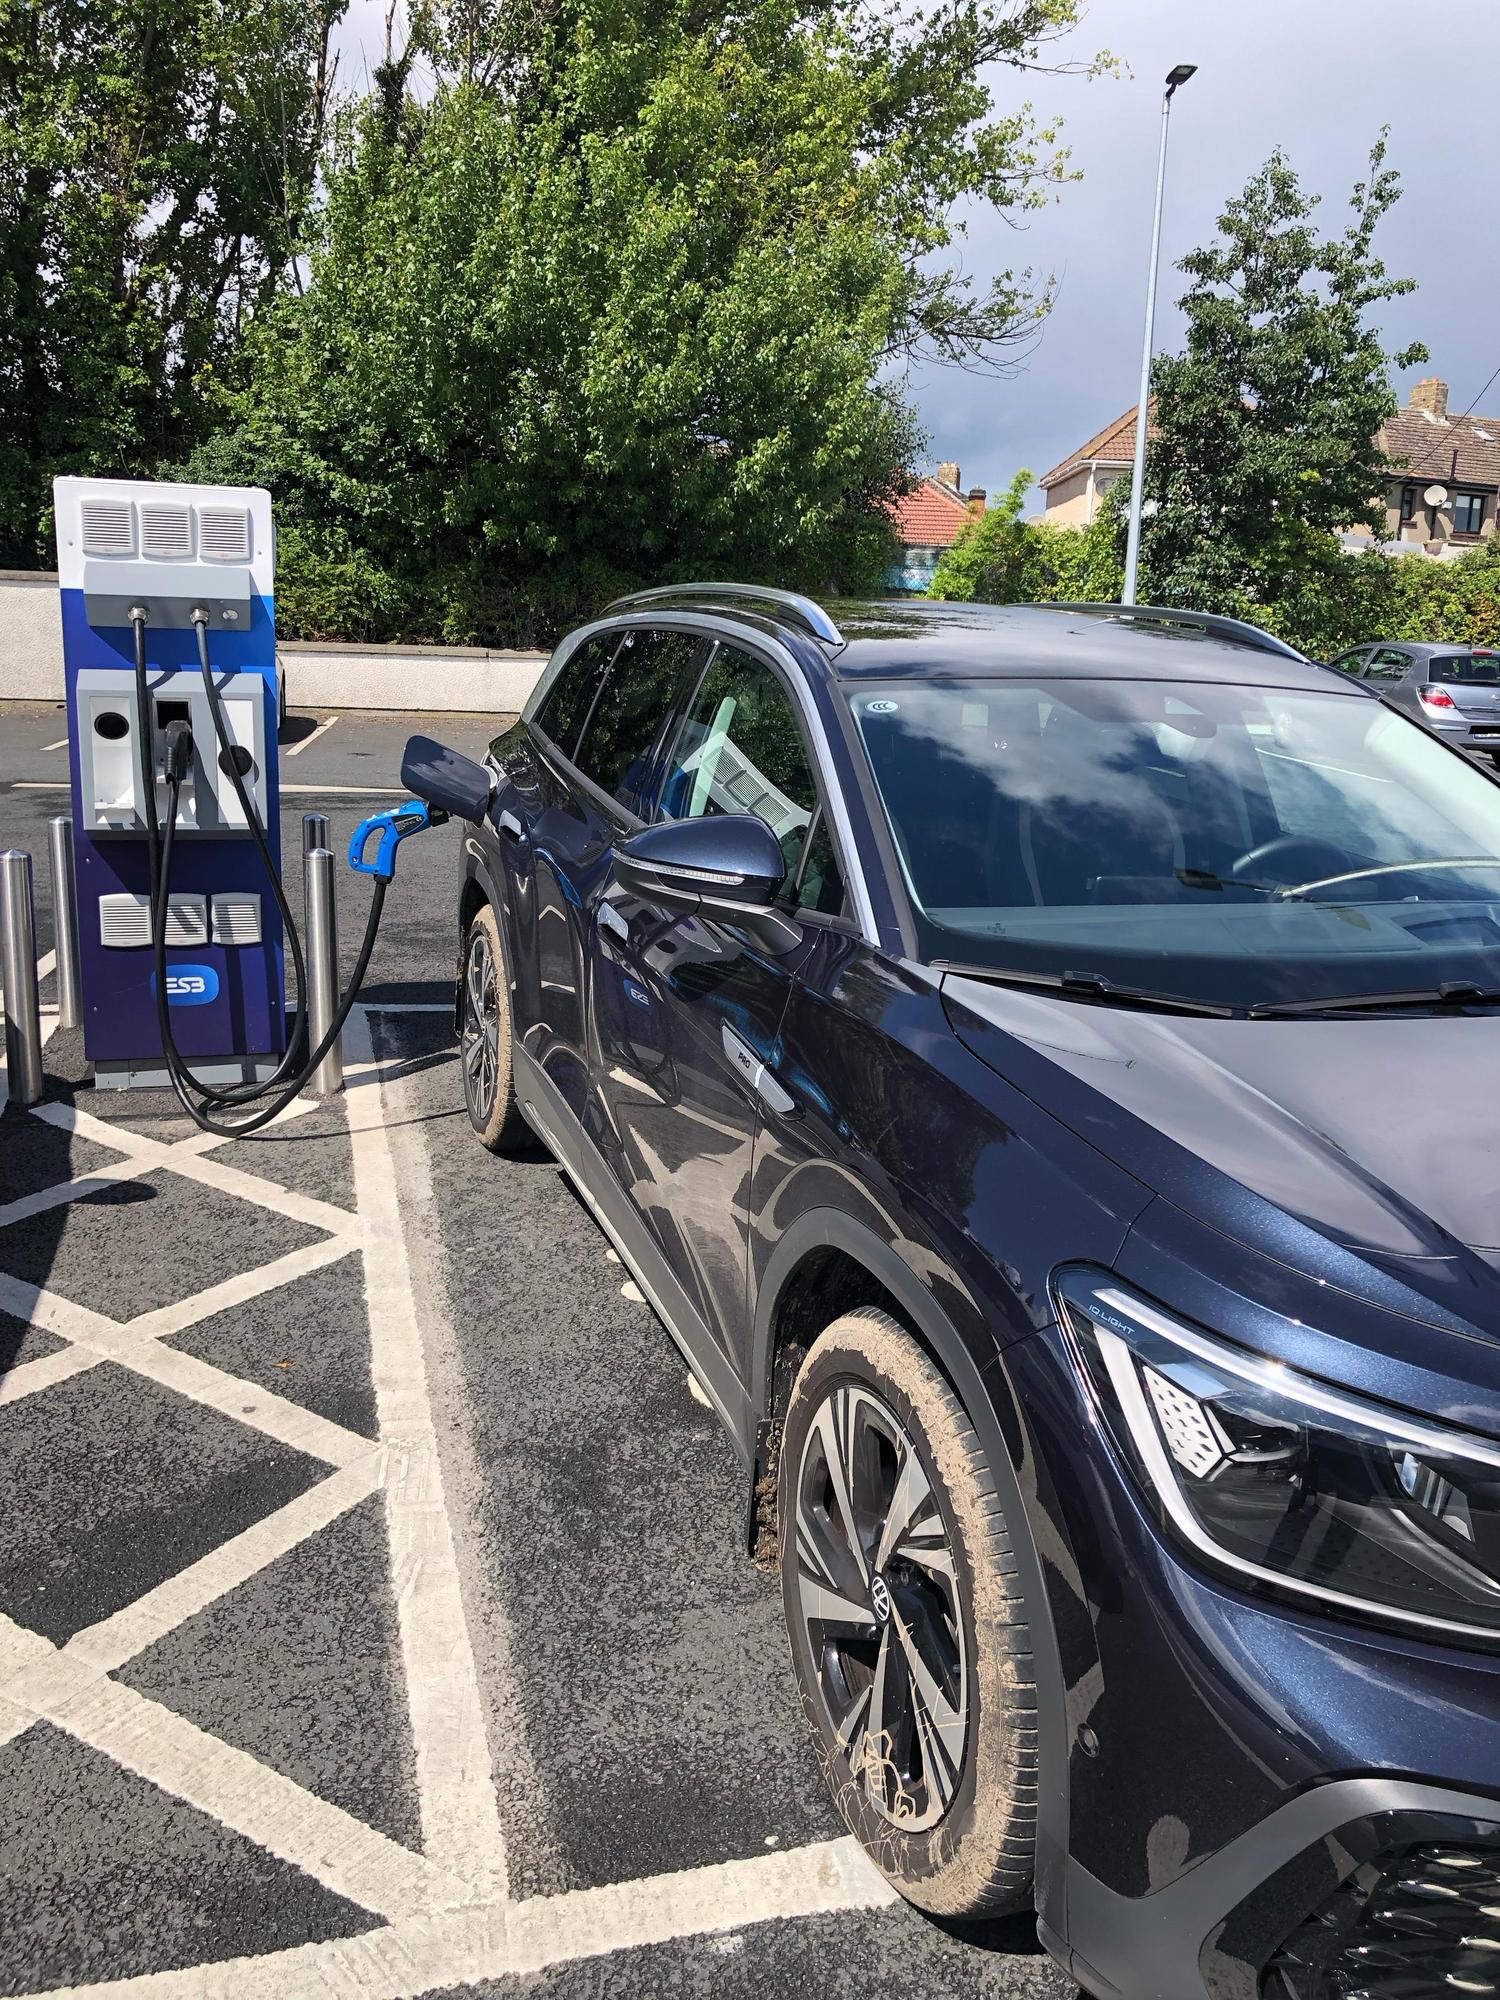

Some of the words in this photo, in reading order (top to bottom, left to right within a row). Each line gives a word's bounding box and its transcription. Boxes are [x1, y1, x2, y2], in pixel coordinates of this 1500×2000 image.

[166, 976, 206, 994] ESB
[738, 1051, 751, 1069] PRO
[1088, 1304, 1136, 1335] IQ.LIGHT
